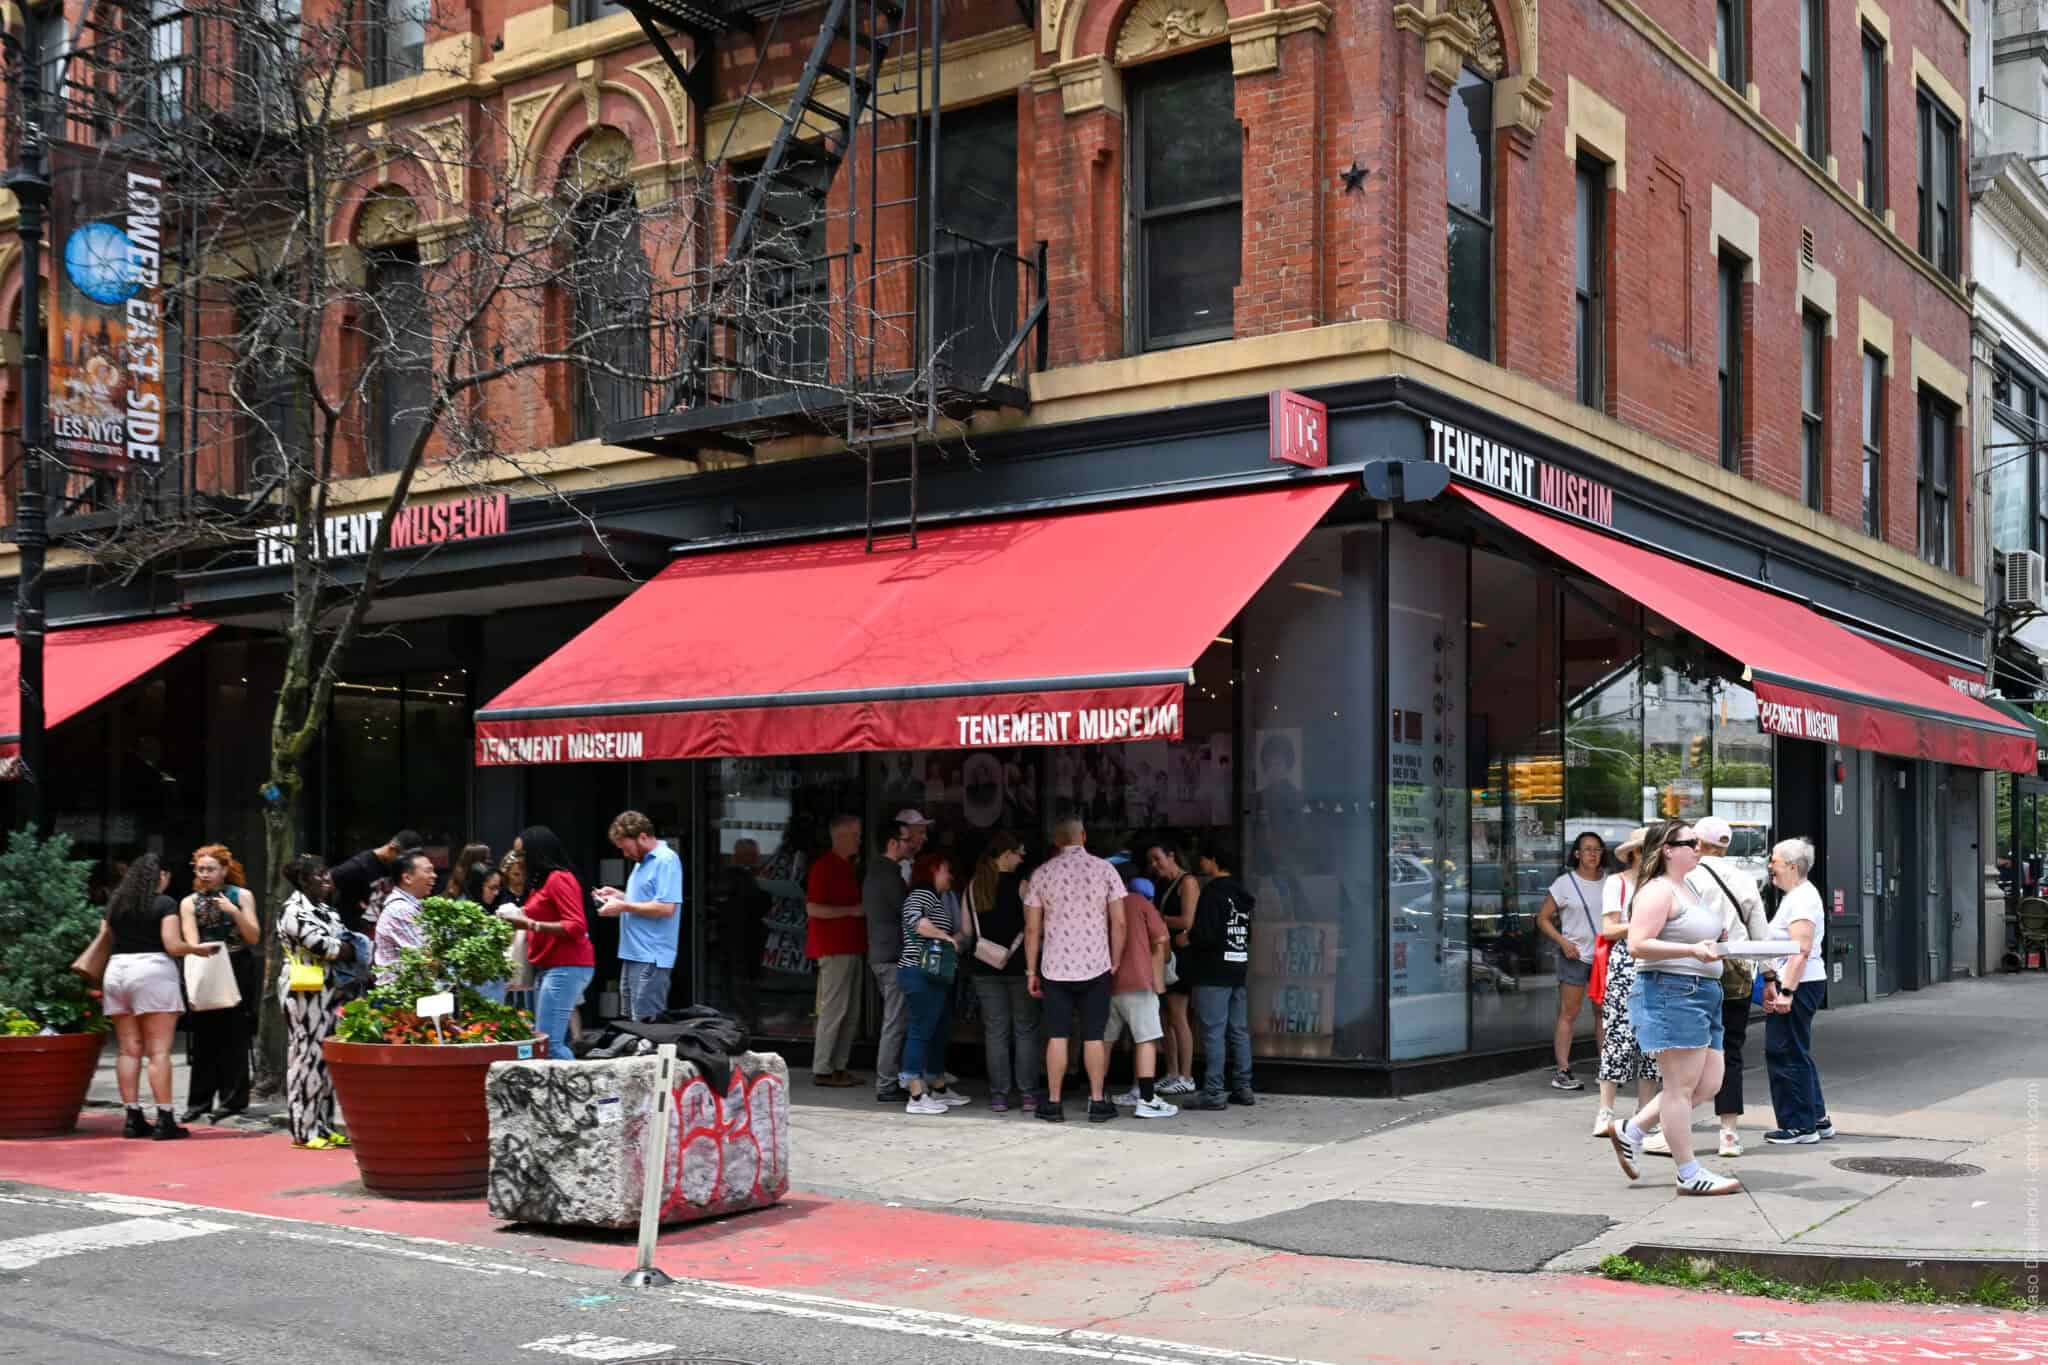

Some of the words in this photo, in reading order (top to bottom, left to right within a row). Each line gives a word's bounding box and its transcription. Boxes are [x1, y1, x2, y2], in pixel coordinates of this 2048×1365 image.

[127, 171, 161, 289] LOWER
[127, 298, 160, 382] EAST
[54, 415, 123, 444] LES.NYC
[127, 389, 161, 462] SIDE
[1430, 420, 1535, 497] TENEMENT
[1540, 463, 1613, 528] MUSEUM
[255, 511, 383, 566] TENENT
[390, 493, 508, 549] MUSEUM
[480, 735, 564, 762] TENEMENT
[567, 731, 643, 759] MUSEUM
[957, 711, 1072, 745] TENEMENT
[1078, 703, 1179, 740] MUSEUM
[1804, 706, 1839, 743] MUSEUM
